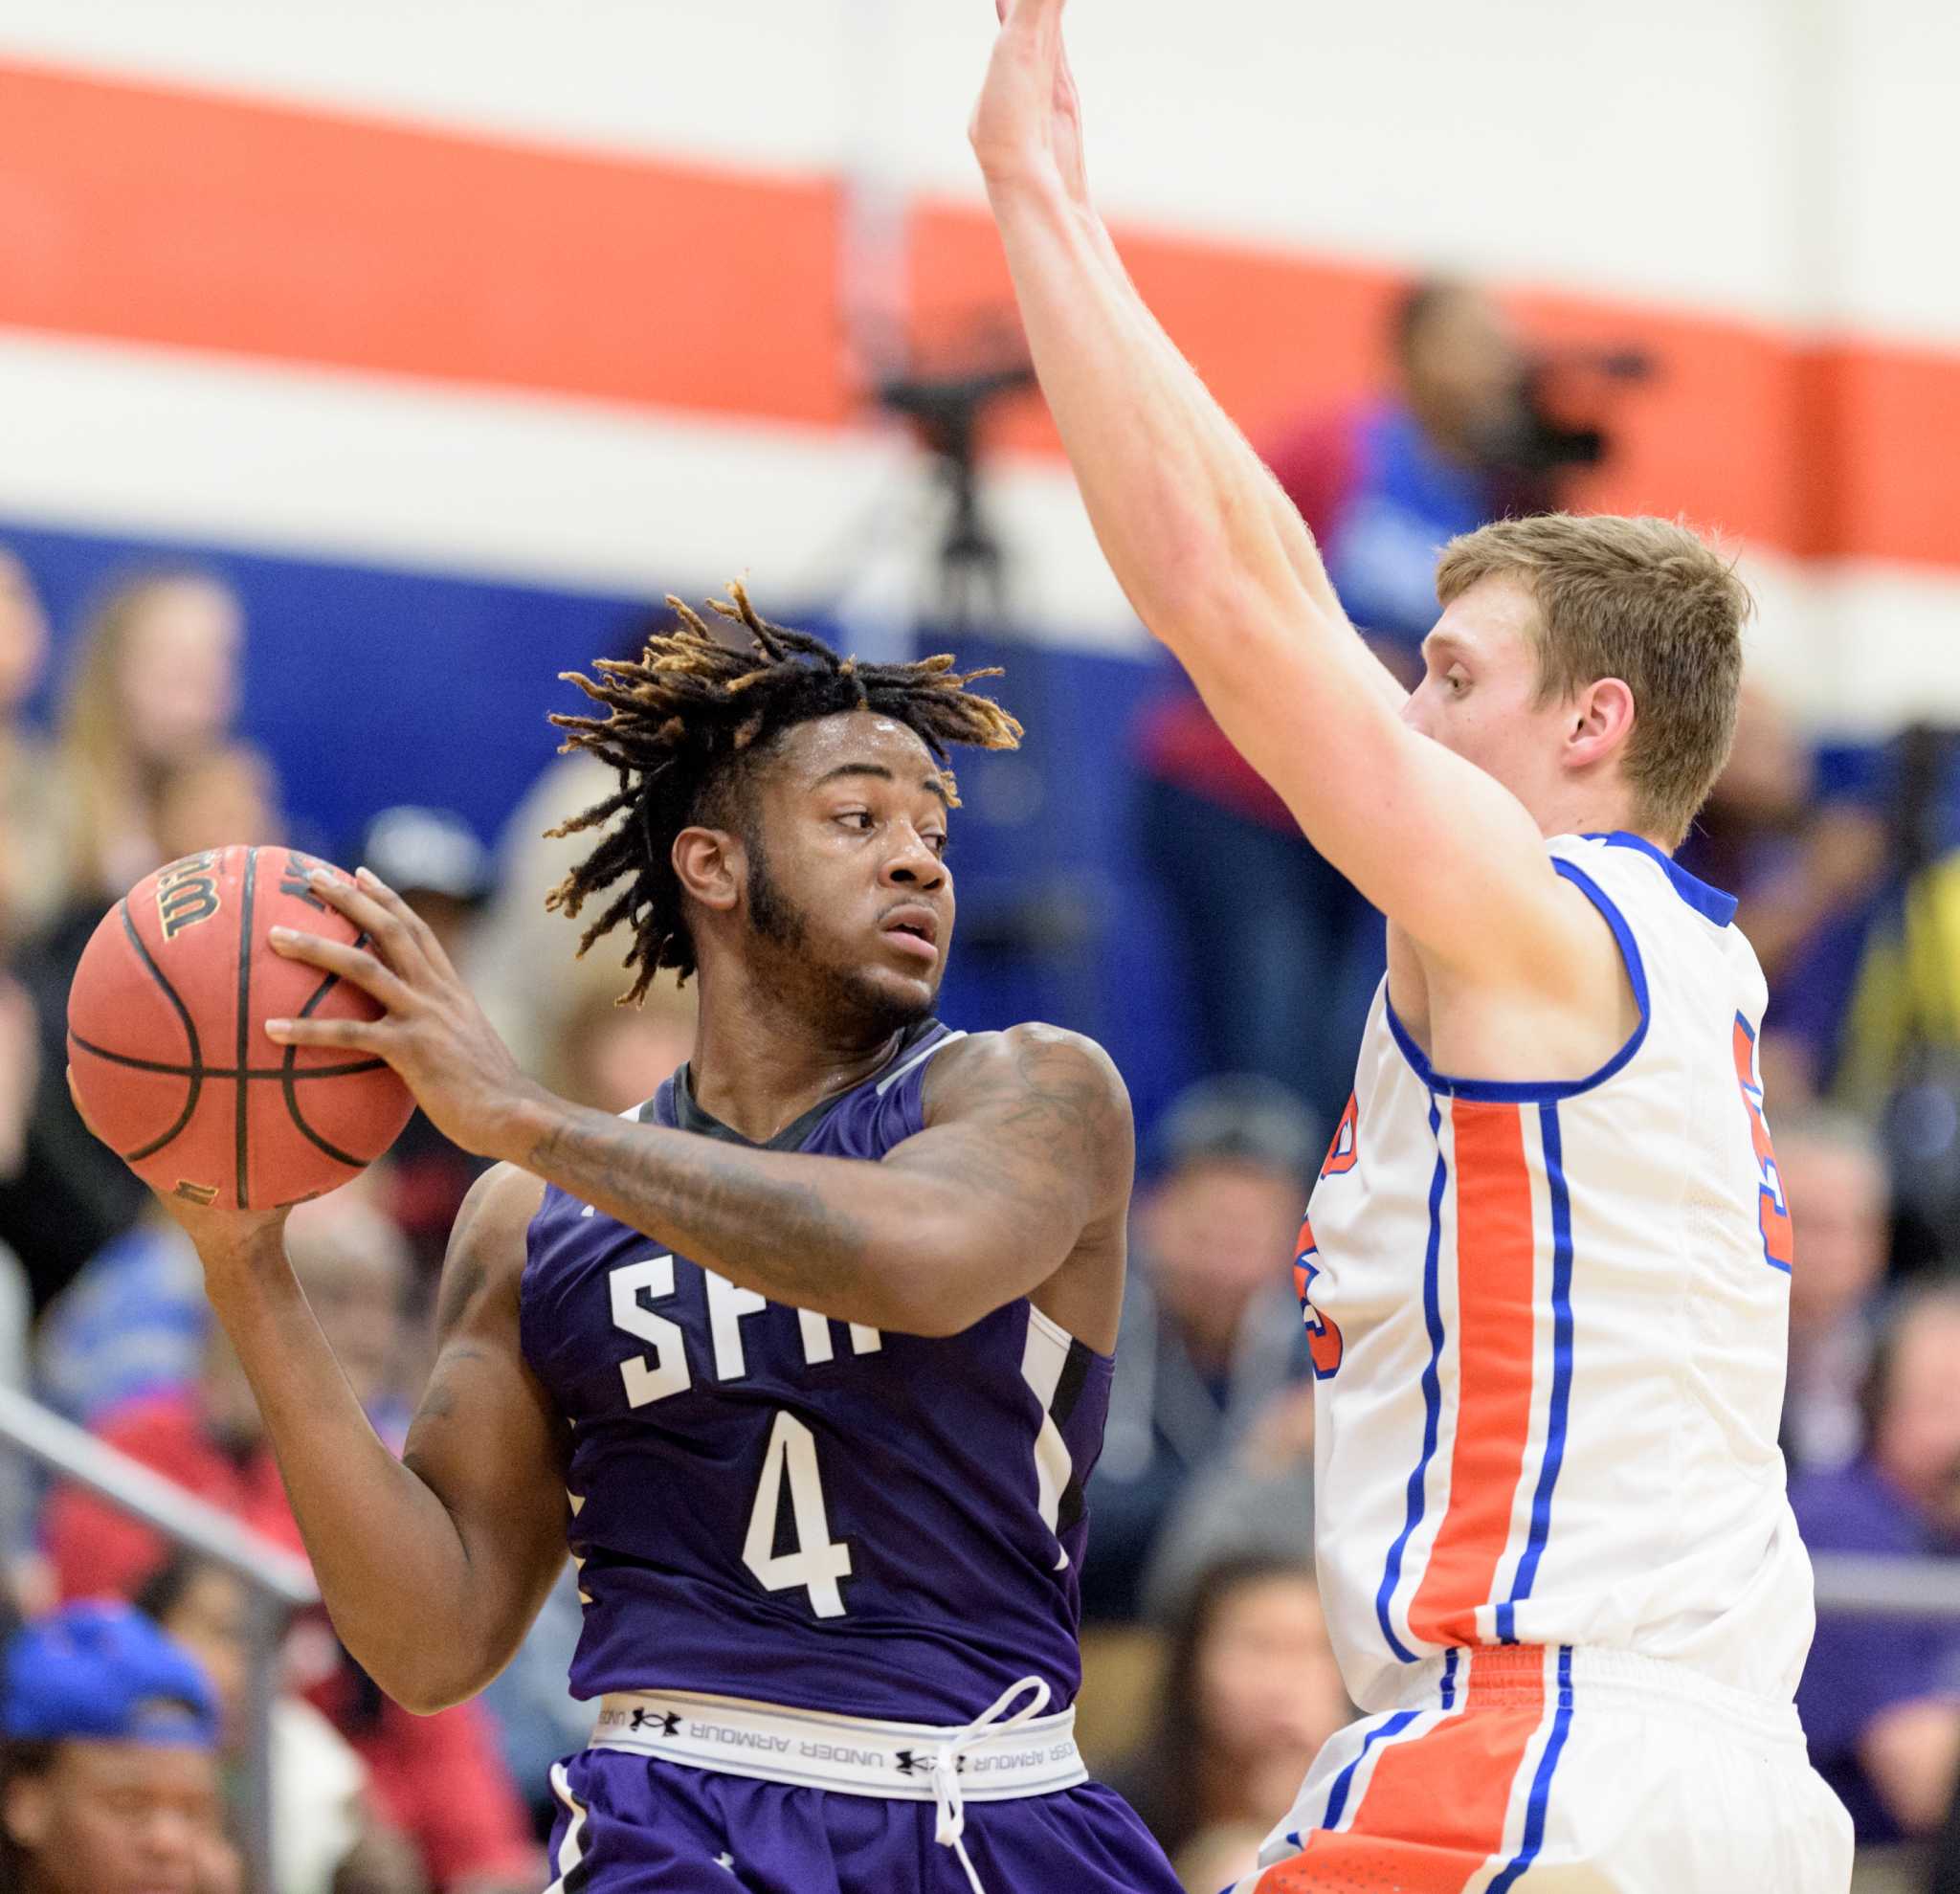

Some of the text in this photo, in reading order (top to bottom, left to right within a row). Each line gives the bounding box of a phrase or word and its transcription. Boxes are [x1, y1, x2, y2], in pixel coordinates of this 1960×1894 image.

[742, 1409, 853, 1618] 4
[690, 1722, 883, 1768] UNDER ARMOUR
[974, 1750, 1044, 1771] ARMOUR
